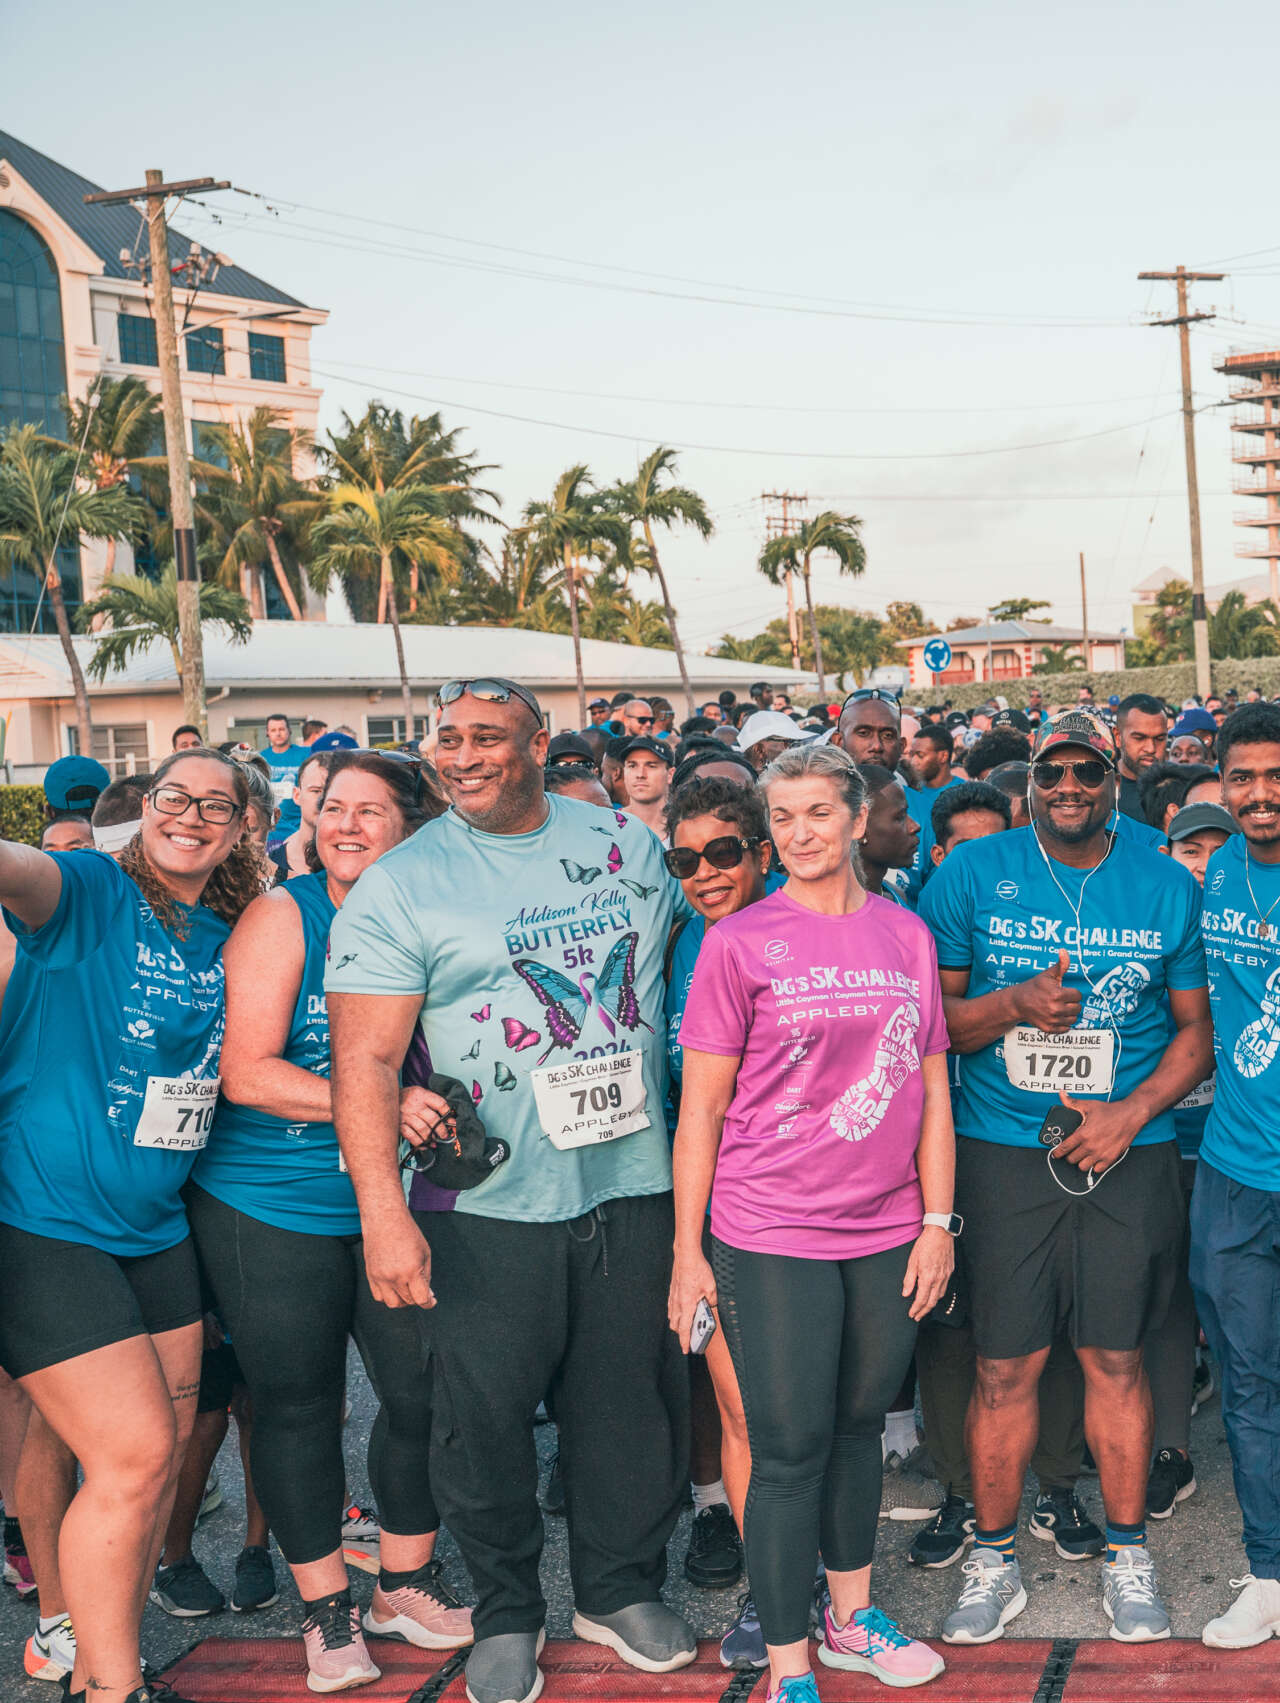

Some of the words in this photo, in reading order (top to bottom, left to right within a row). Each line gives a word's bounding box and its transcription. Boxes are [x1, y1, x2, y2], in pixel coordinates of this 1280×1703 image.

[502, 905, 577, 935] Addison
[580, 889, 627, 914] Kelly
[1221, 908, 1247, 935] 5K
[505, 909, 633, 956] BUTTERFLY
[1029, 916, 1062, 943] 5K
[1063, 926, 1163, 950] CHALLENGE
[1234, 938, 1260, 950] Cayman
[989, 938, 1008, 947] Little
[1009, 941, 1042, 952] Cayman
[1083, 948, 1101, 957] Brac
[1107, 950, 1132, 958] Grand
[1133, 951, 1162, 960] Cayman
[809, 966, 844, 990] 5K
[843, 968, 920, 998] CHALLENGE
[776, 997, 795, 1008] Little
[796, 993, 828, 1004] Cayman
[835, 991, 867, 1000] Cayman
[867, 989, 885, 997] Brac
[776, 1003, 883, 1027] APPLEBY
[1053, 1033, 1101, 1045] CHALLENGE
[1245, 1032, 1267, 1056] 10
[878, 1038, 920, 1073] CHALLENGE
[1025, 1052, 1092, 1078] 1720
[567, 1064, 585, 1079] 5K
[586, 1058, 632, 1075] CHALLENGE
[1019, 1080, 1096, 1092] APPLEBY
[570, 1082, 622, 1116] 709
[850, 1093, 877, 1119] 10
[561, 1110, 635, 1134] APPLEBY
[778, 1124, 794, 1133] EY
[597, 1130, 614, 1140] 709
